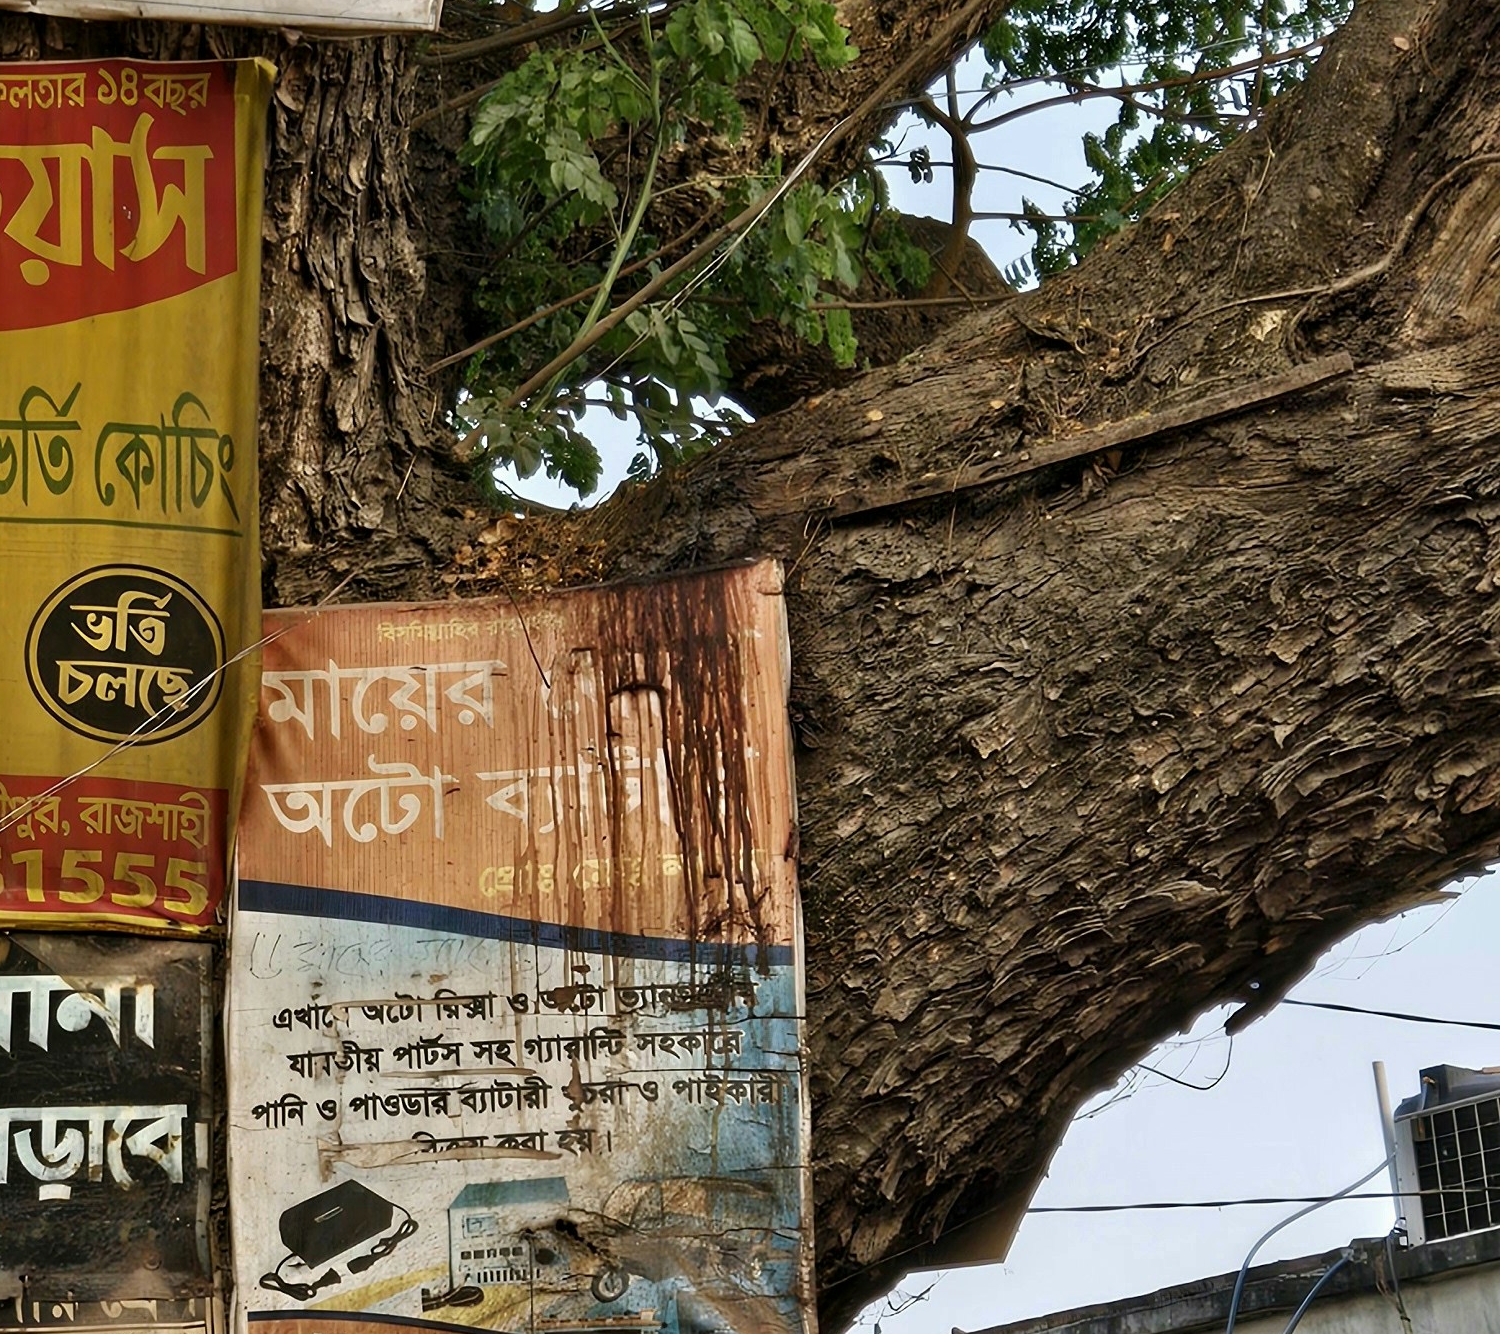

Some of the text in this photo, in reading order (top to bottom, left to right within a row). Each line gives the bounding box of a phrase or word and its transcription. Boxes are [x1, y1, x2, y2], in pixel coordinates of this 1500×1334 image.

[96, 68, 139, 109] ১৪
[142, 72, 212, 116] বছর
[94, 391, 241, 523] কোচিং
[69, 591, 175, 657] ভর্তি
[55, 659, 193, 713] চলছে
[261, 657, 508, 742] মায়ের
[79, 779, 211, 847] রাজশাহী
[260, 754, 460, 849] অটো
[392, 1033, 464, 1070] পার্টস
[469, 1039, 517, 1067] সহ
[524, 1027, 627, 1063] গ্যারান্টি
[633, 1027, 745, 1059] সহকারে
[251, 1092, 309, 1129] পানি
[316, 1099, 338, 1121] ও
[349, 1091, 451, 1121] পাওডার
[458, 1075, 553, 1116] ব্যাটারী
